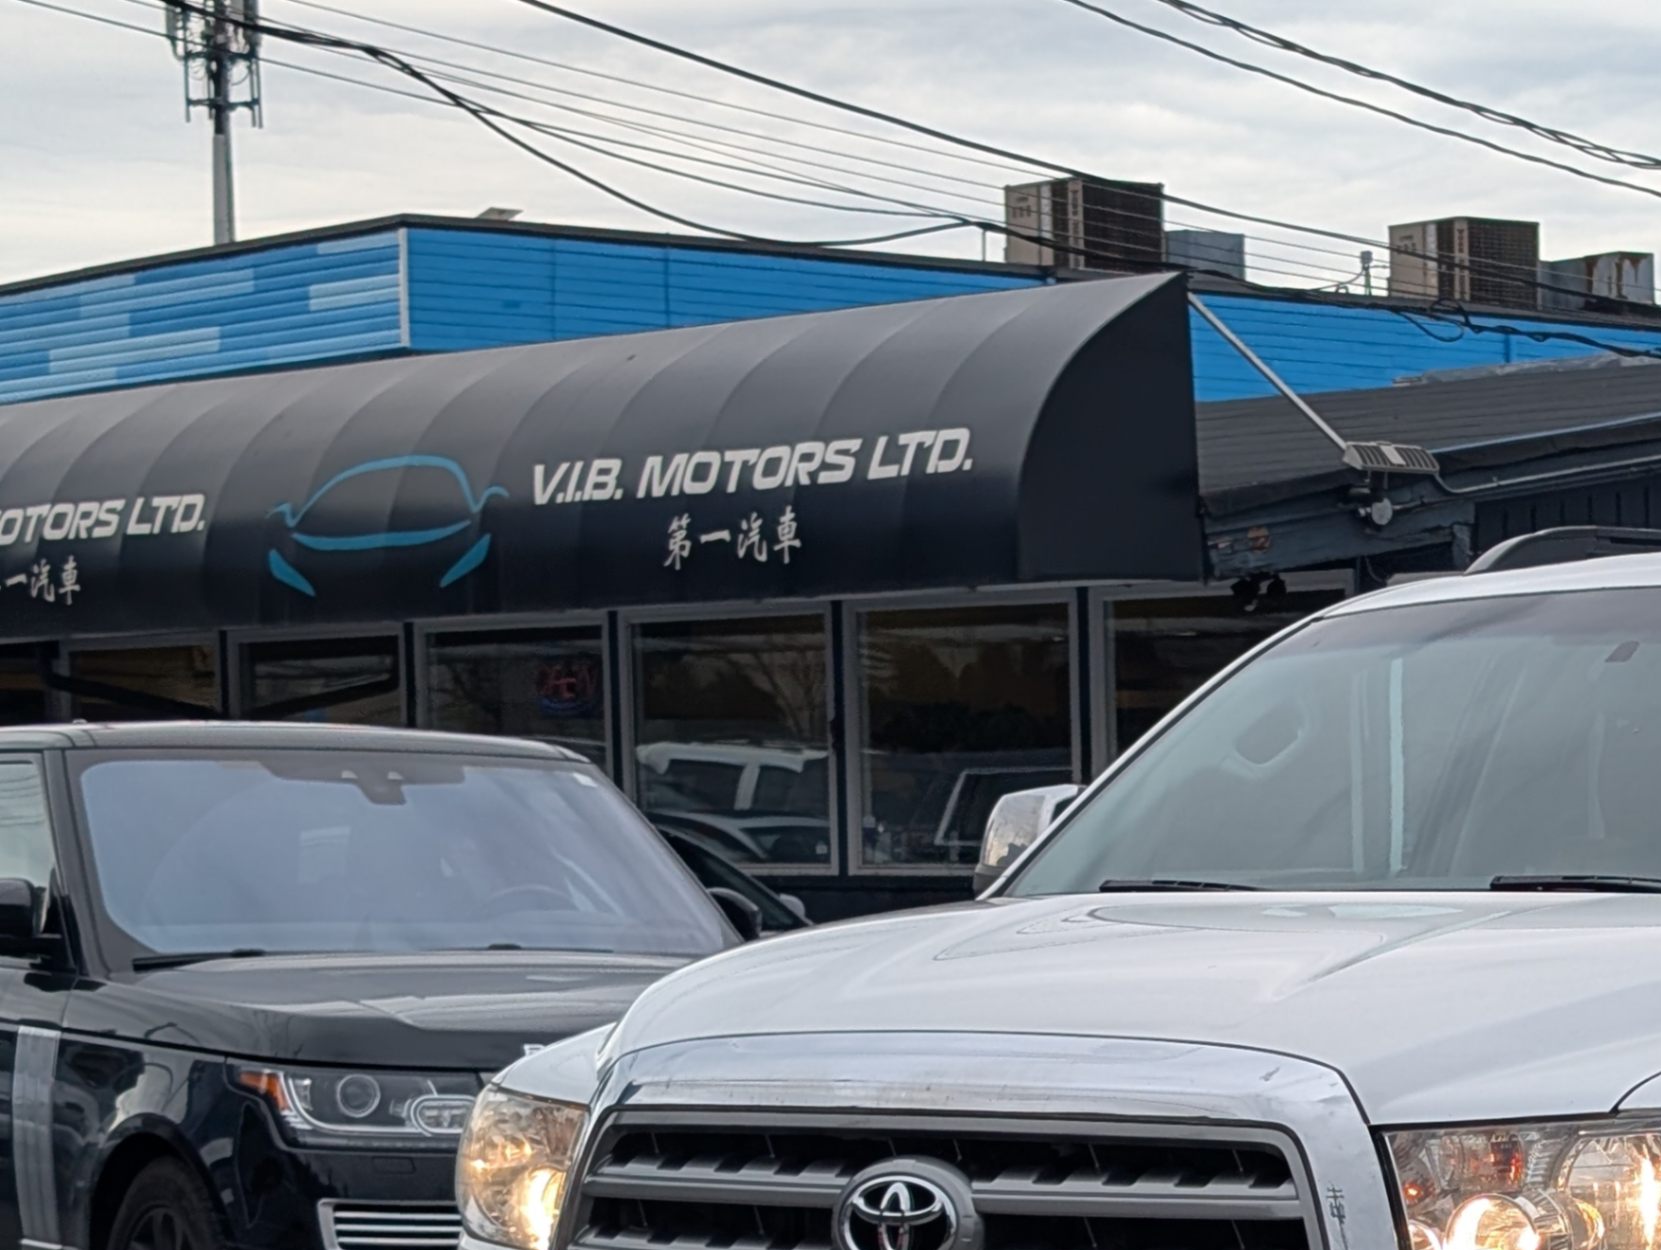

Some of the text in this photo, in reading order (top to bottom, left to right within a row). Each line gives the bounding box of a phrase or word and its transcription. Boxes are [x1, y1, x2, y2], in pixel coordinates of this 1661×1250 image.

[532, 427, 974, 505] V.I.B. MOTORS LTD.
[0, 493, 206, 546] OTORS LTD.
[662, 505, 803, 570] 第一汽車
[0, 555, 81, 605] 一汽車
